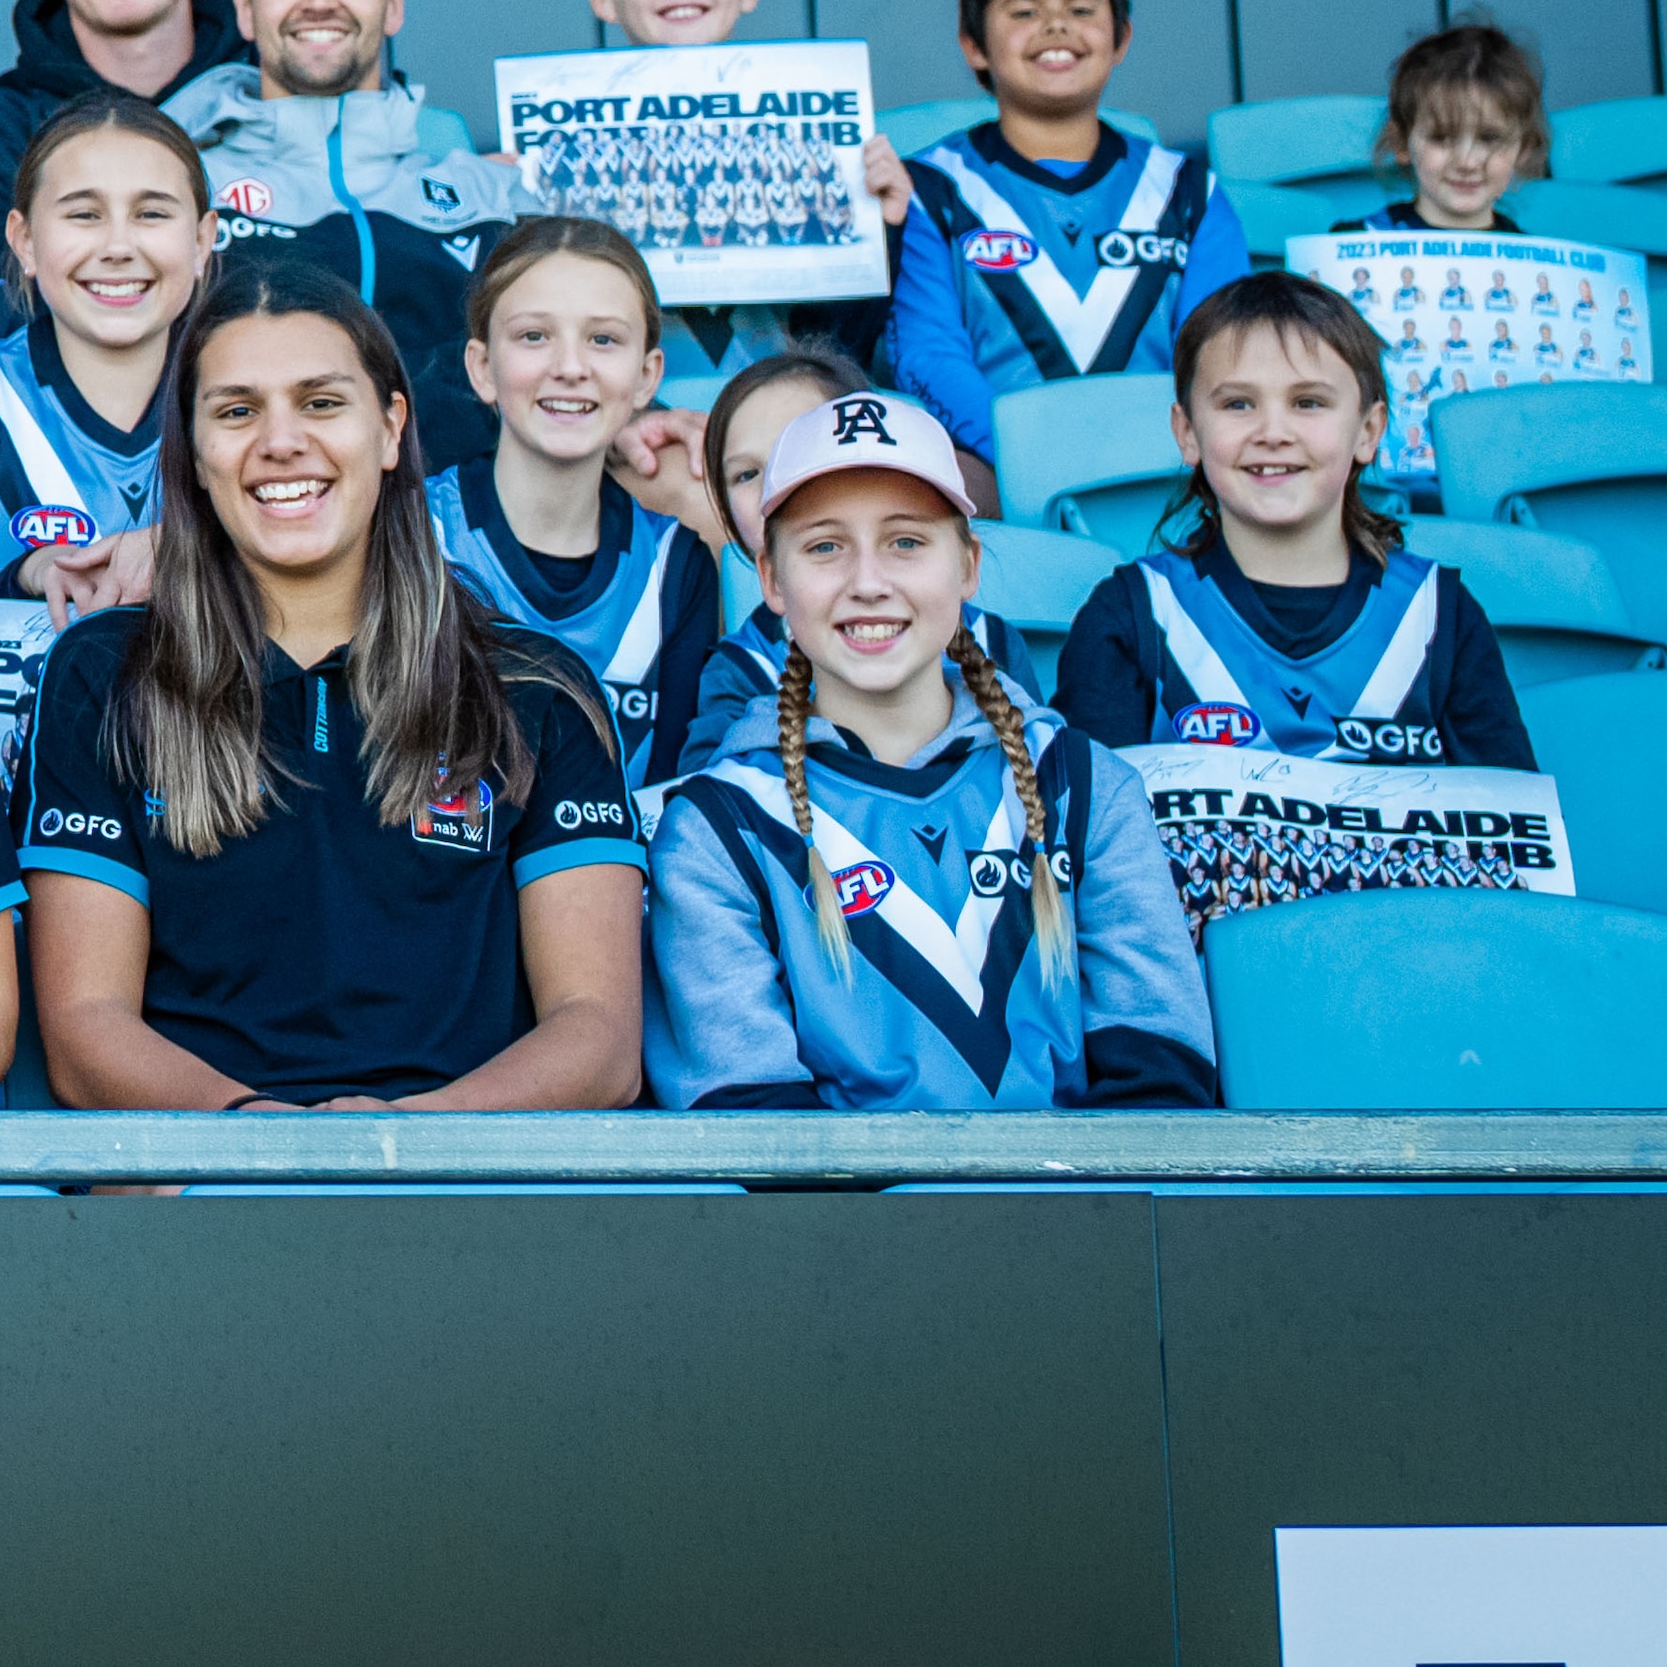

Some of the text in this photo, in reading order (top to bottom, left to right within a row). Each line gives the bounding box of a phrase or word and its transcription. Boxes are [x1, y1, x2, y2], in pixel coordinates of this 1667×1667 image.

[512, 90, 860, 127] PORT ADELAIDE
[964, 235, 1032, 262] AFL
[18, 515, 89, 542] AFL
[1180, 712, 1253, 741] AFL
[1373, 724, 1442, 757] GFG
[64, 813, 122, 840] GFG
[582, 801, 624, 826] GFG
[1147, 789, 1233, 820] RT
[1239, 791, 1551, 842] ADELAIDE
[433, 821, 459, 837] nab
